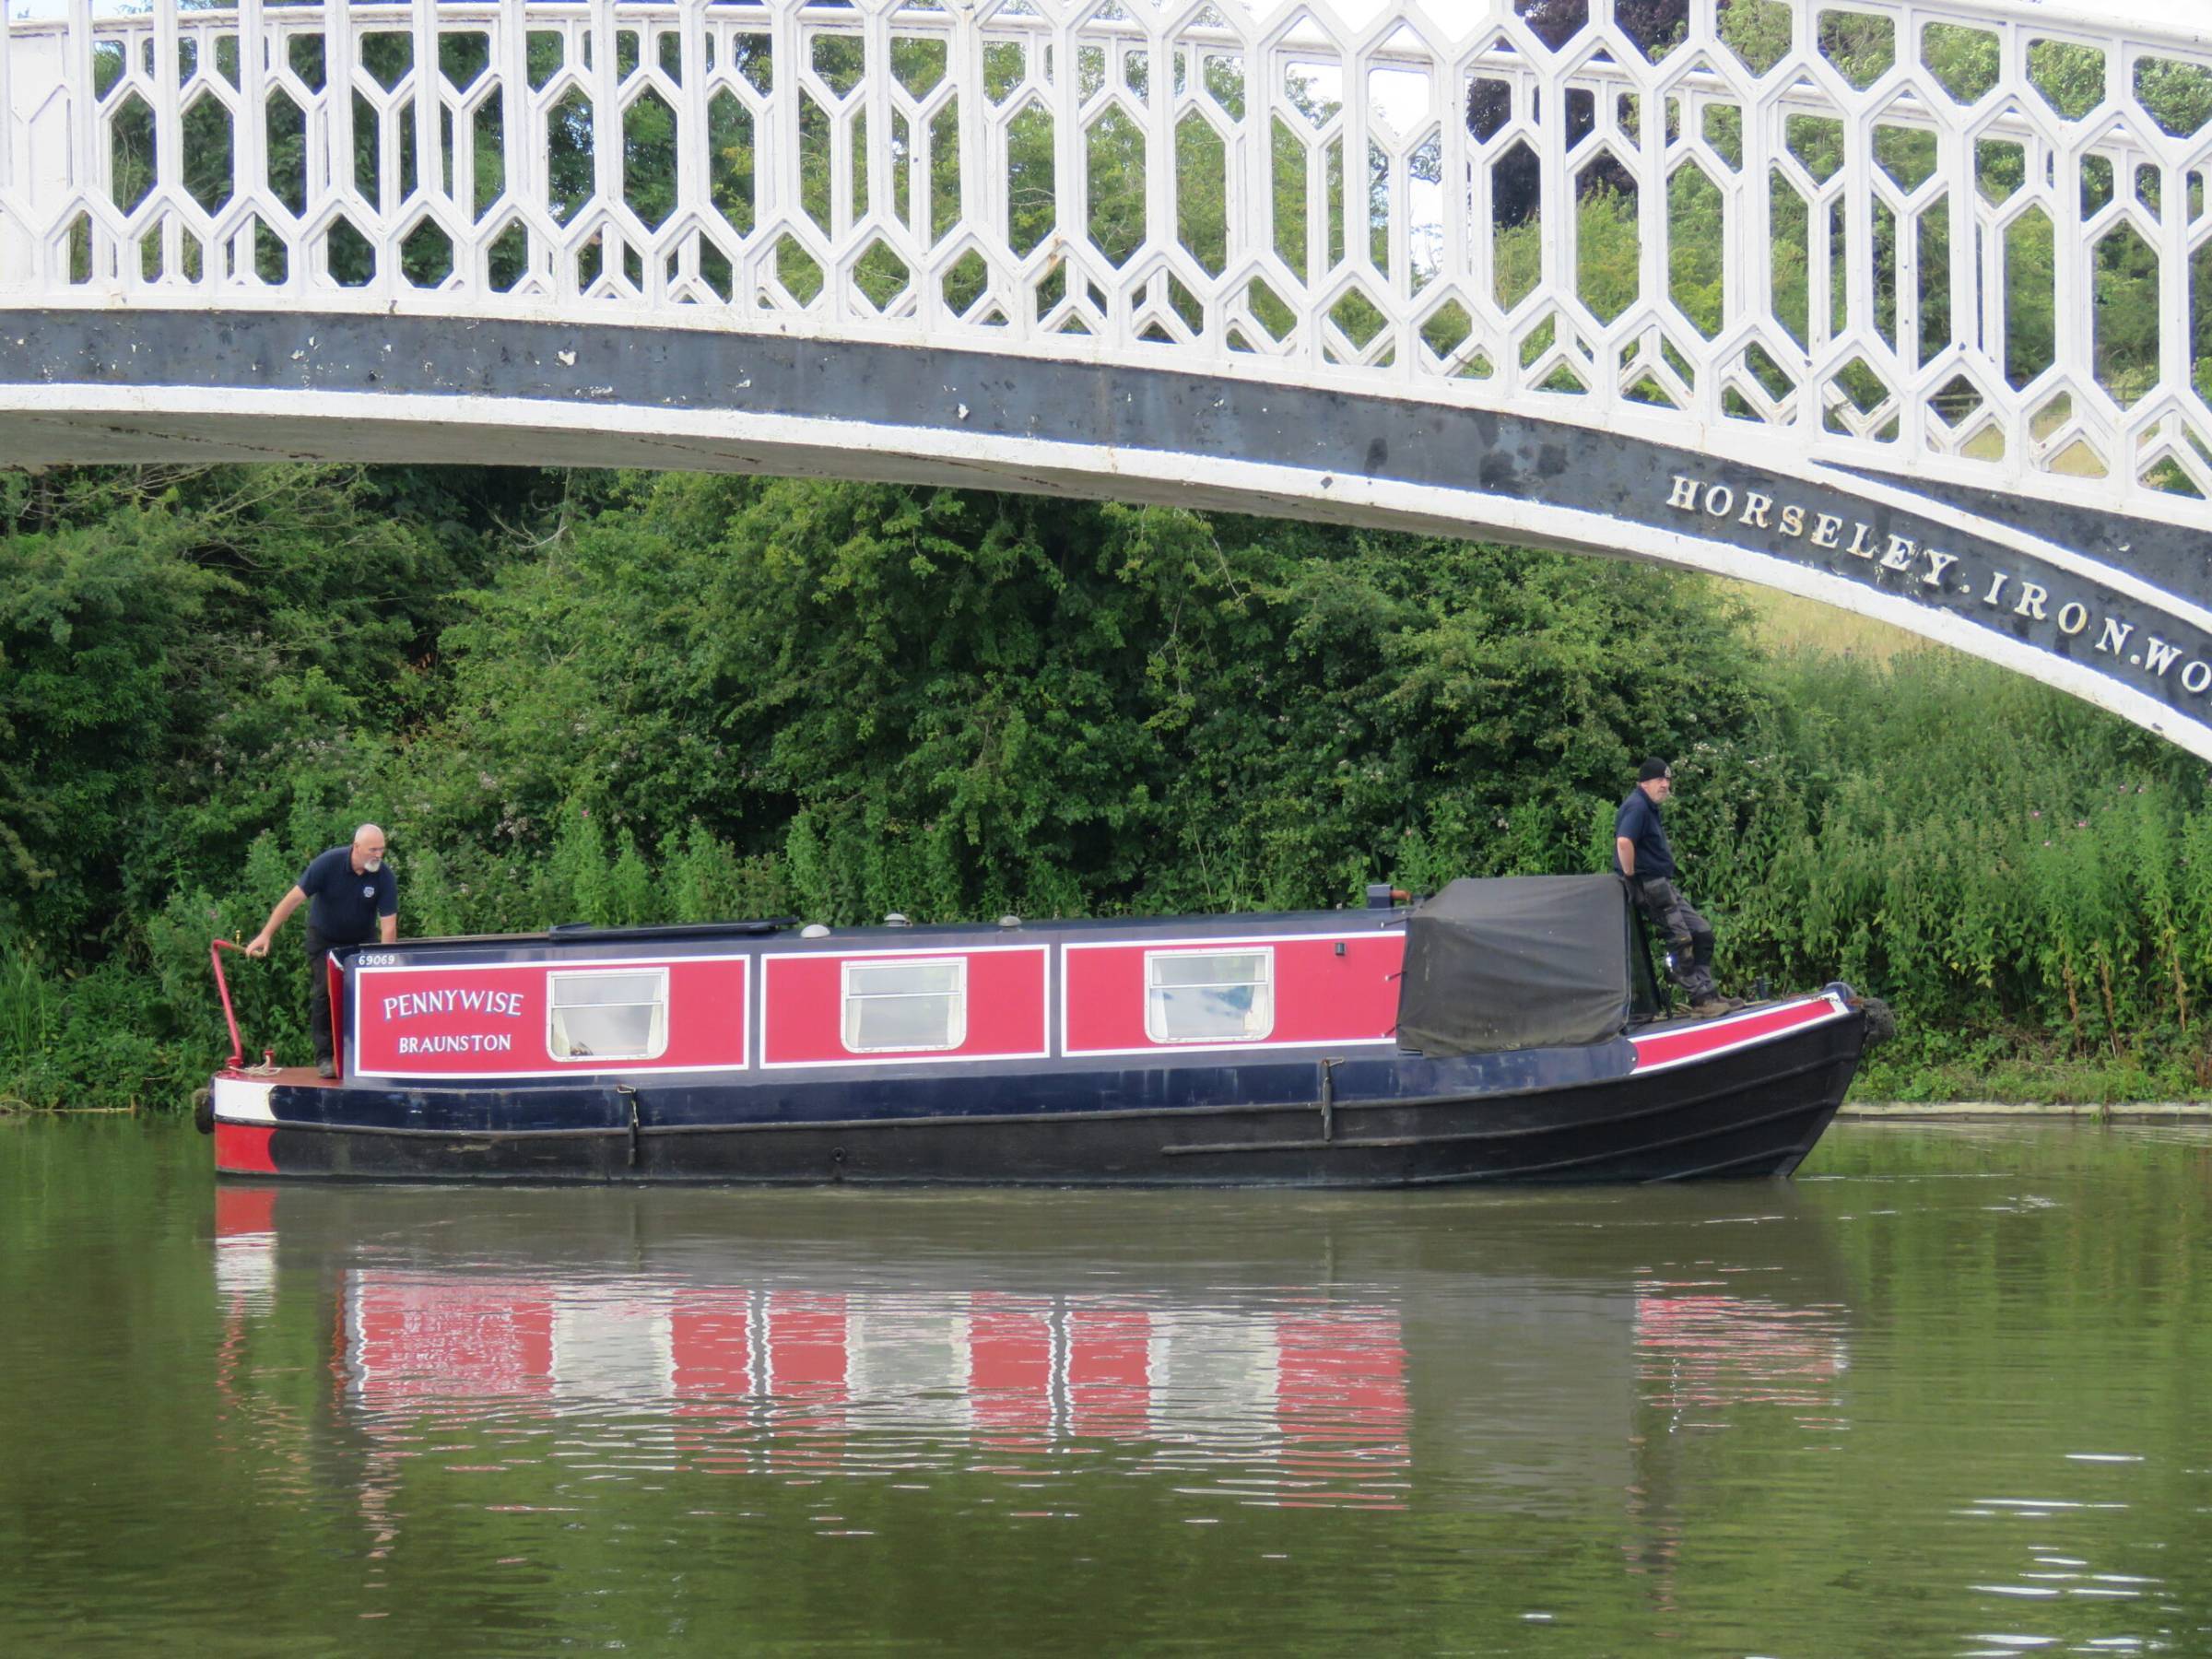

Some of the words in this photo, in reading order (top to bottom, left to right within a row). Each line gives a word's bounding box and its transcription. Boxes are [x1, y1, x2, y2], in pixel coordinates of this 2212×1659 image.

[358, 955, 395, 966] 69069
[383, 989, 524, 1021] PENNYWISE
[398, 1034, 512, 1054] BRAUNSTON
